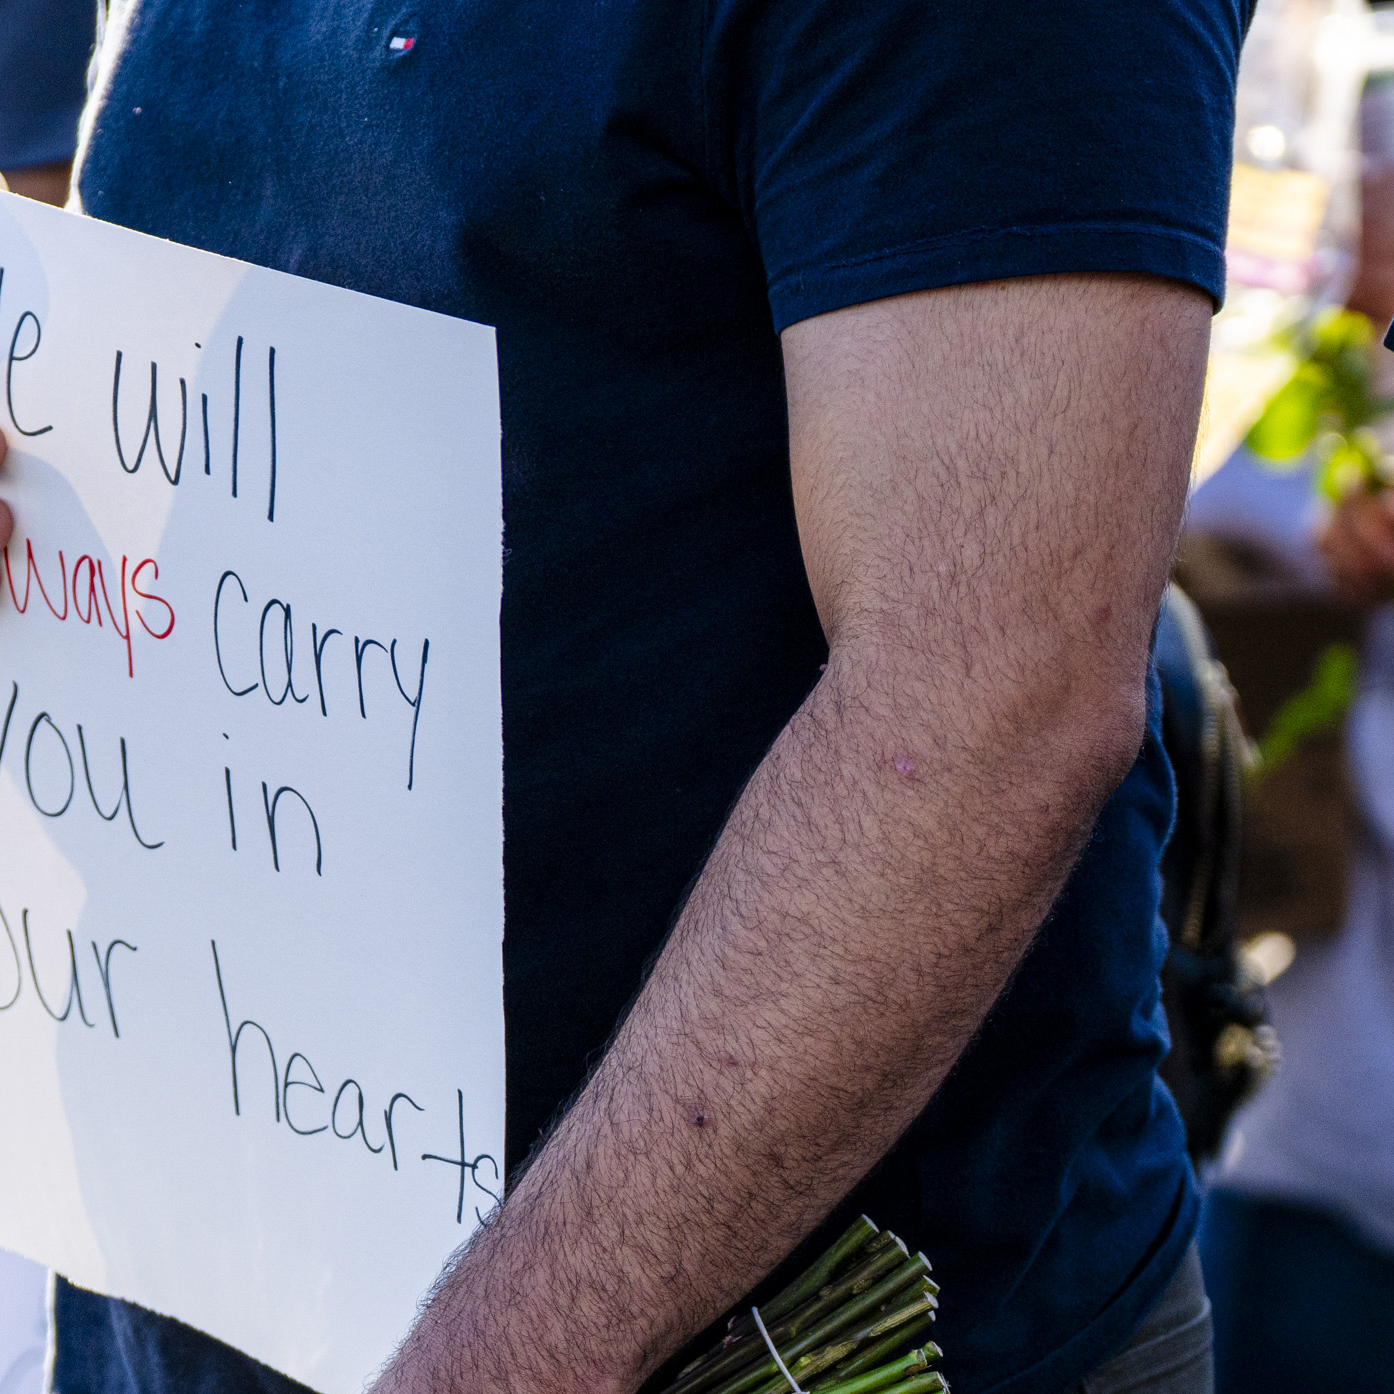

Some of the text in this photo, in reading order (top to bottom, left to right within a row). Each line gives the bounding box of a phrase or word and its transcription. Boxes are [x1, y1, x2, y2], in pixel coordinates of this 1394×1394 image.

[112, 335, 276, 523] will
[213, 570, 430, 791] carry
[222, 732, 323, 876] in
[211, 939, 503, 1227] hearts
